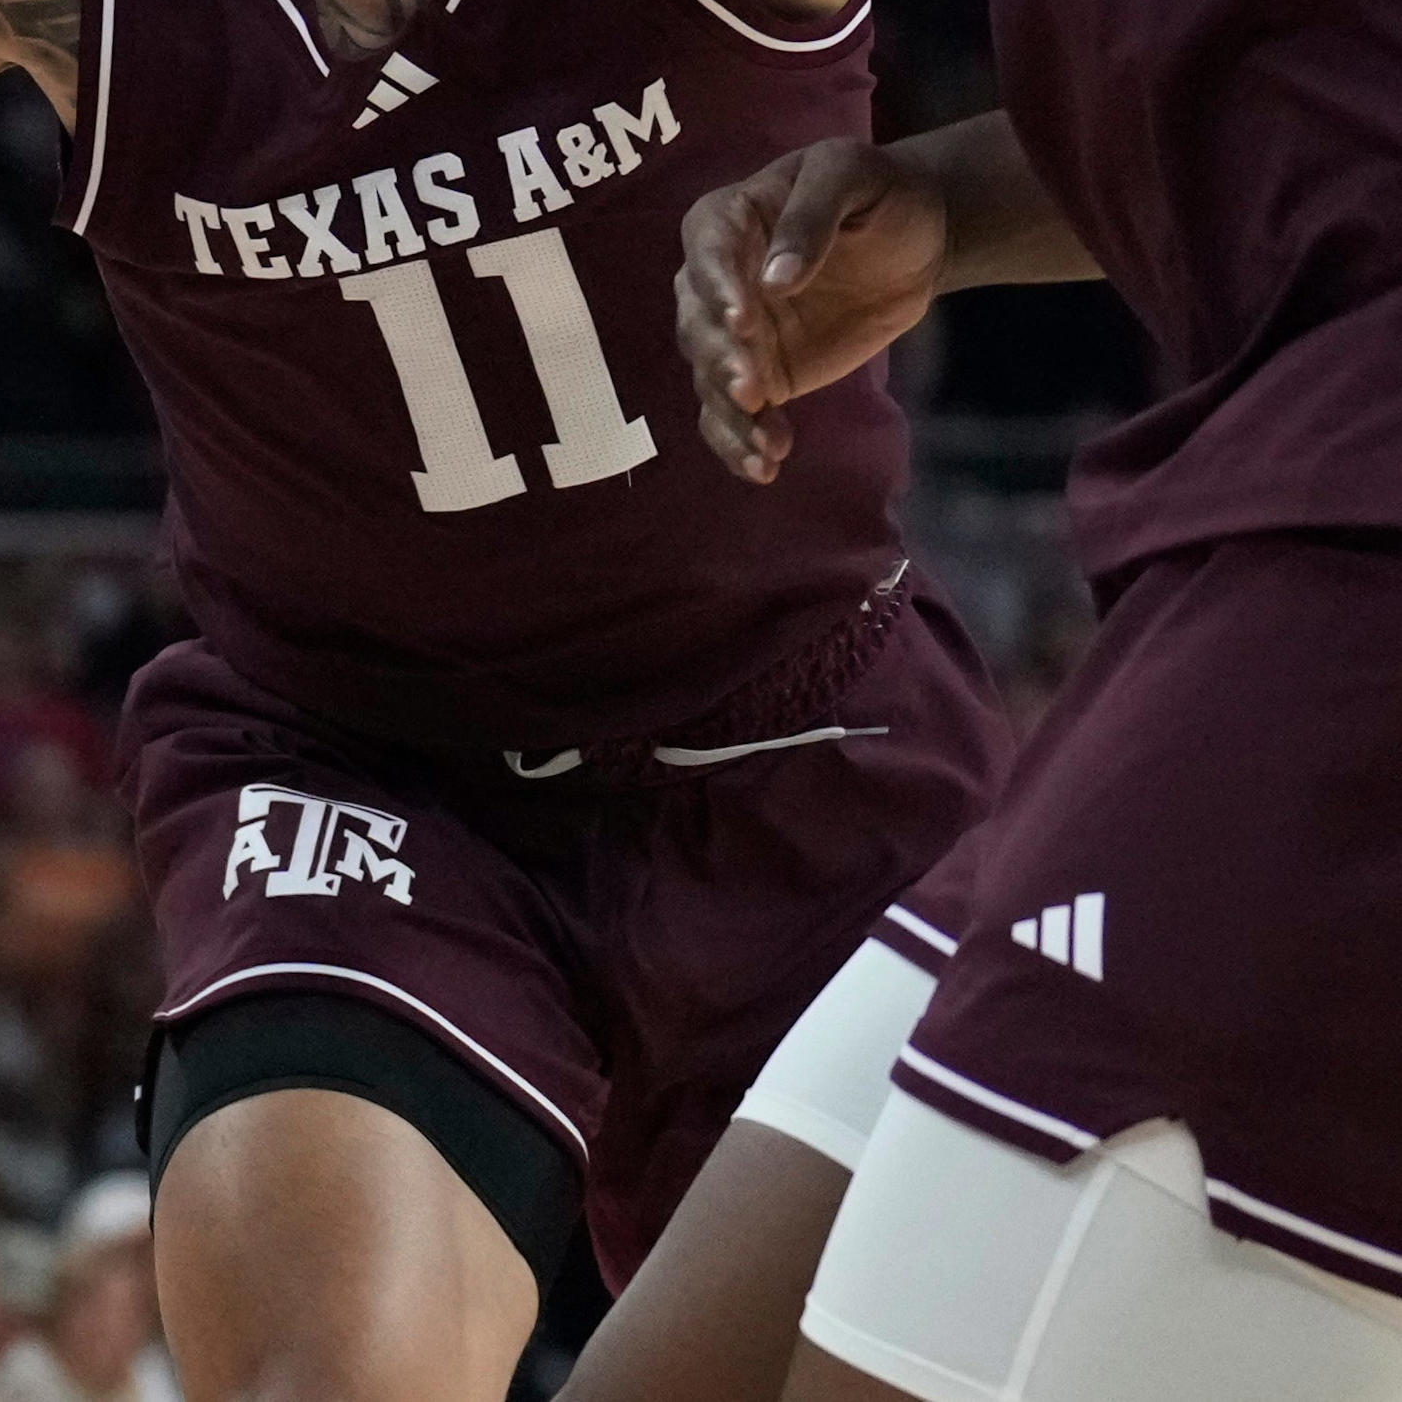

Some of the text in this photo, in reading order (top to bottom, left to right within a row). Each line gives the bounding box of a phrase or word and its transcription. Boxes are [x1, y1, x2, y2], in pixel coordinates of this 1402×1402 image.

[174, 77, 682, 280] TEXAS A&M
[338, 226, 659, 513] 11
